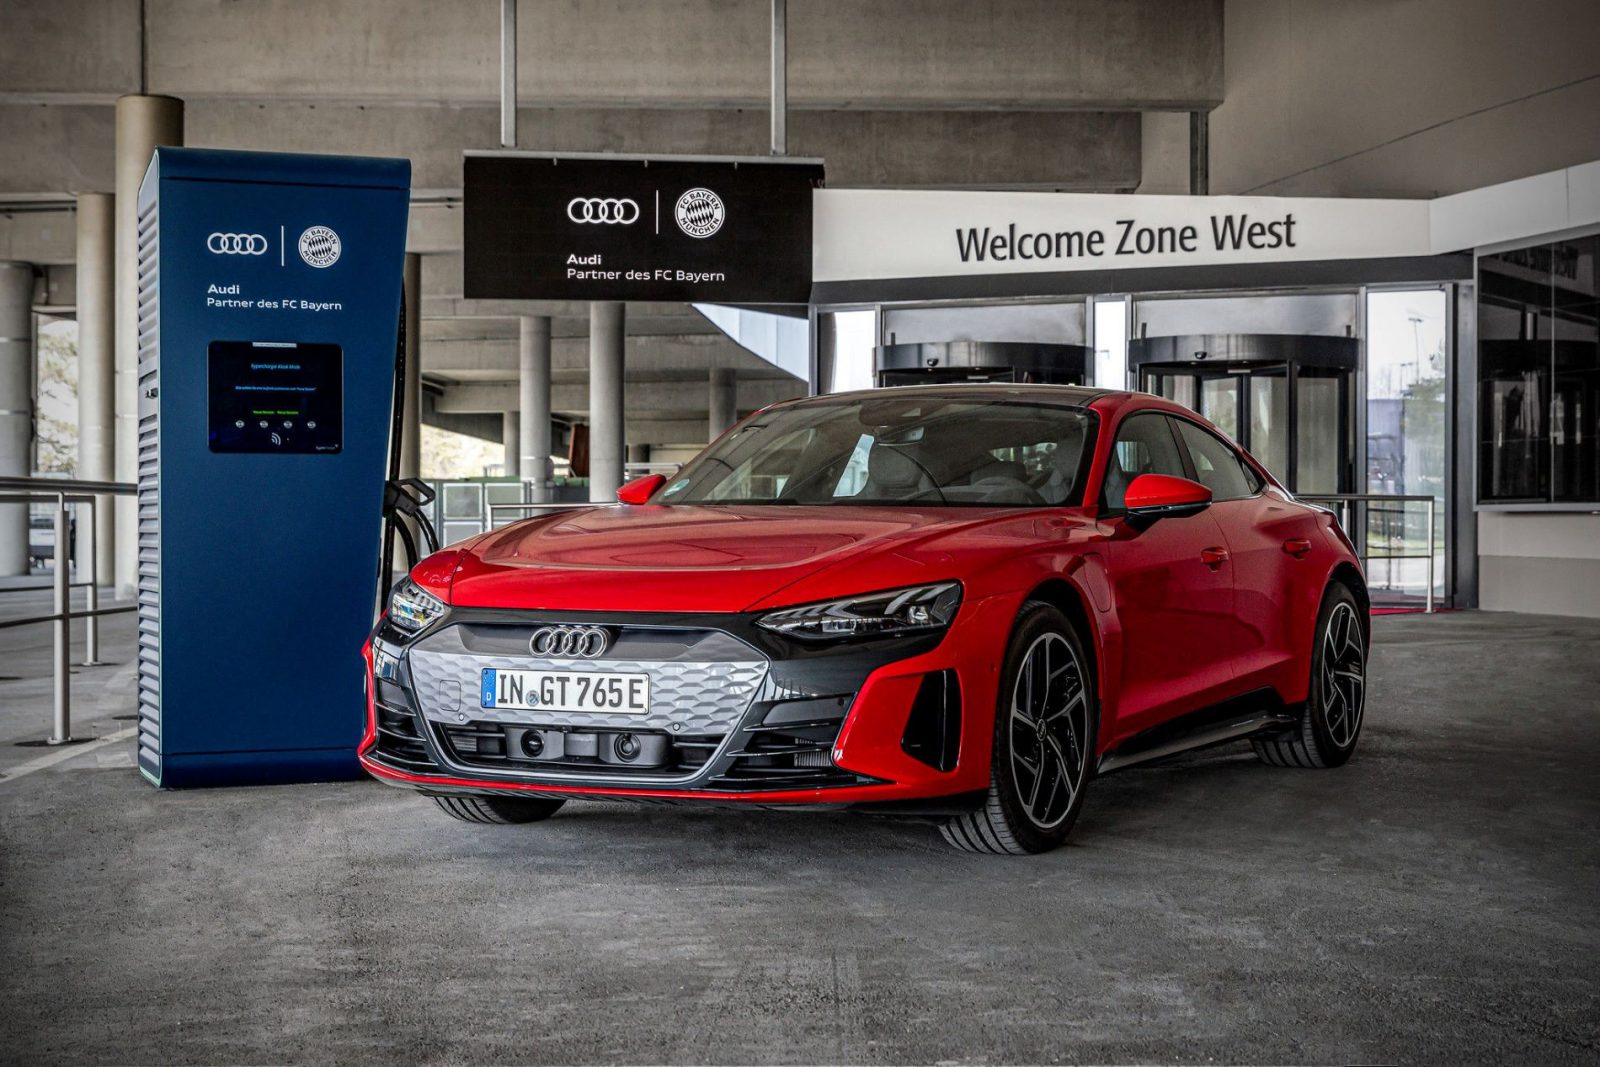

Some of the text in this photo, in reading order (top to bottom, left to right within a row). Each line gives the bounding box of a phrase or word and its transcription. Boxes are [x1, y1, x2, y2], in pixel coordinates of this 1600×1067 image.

[680, 191, 720, 210] FC BAYERN
[302, 229, 338, 245] FC BAYERN
[956, 213, 1296, 262] Welcome Zone West
[566, 254, 602, 265] Audi
[567, 268, 725, 284] Partner des FC Bayern
[207, 284, 240, 295] Audi
[207, 297, 342, 312] Partner des FC Bayern
[485, 692, 492, 701] D
[497, 674, 524, 705] IN
[541, 676, 570, 706] GT
